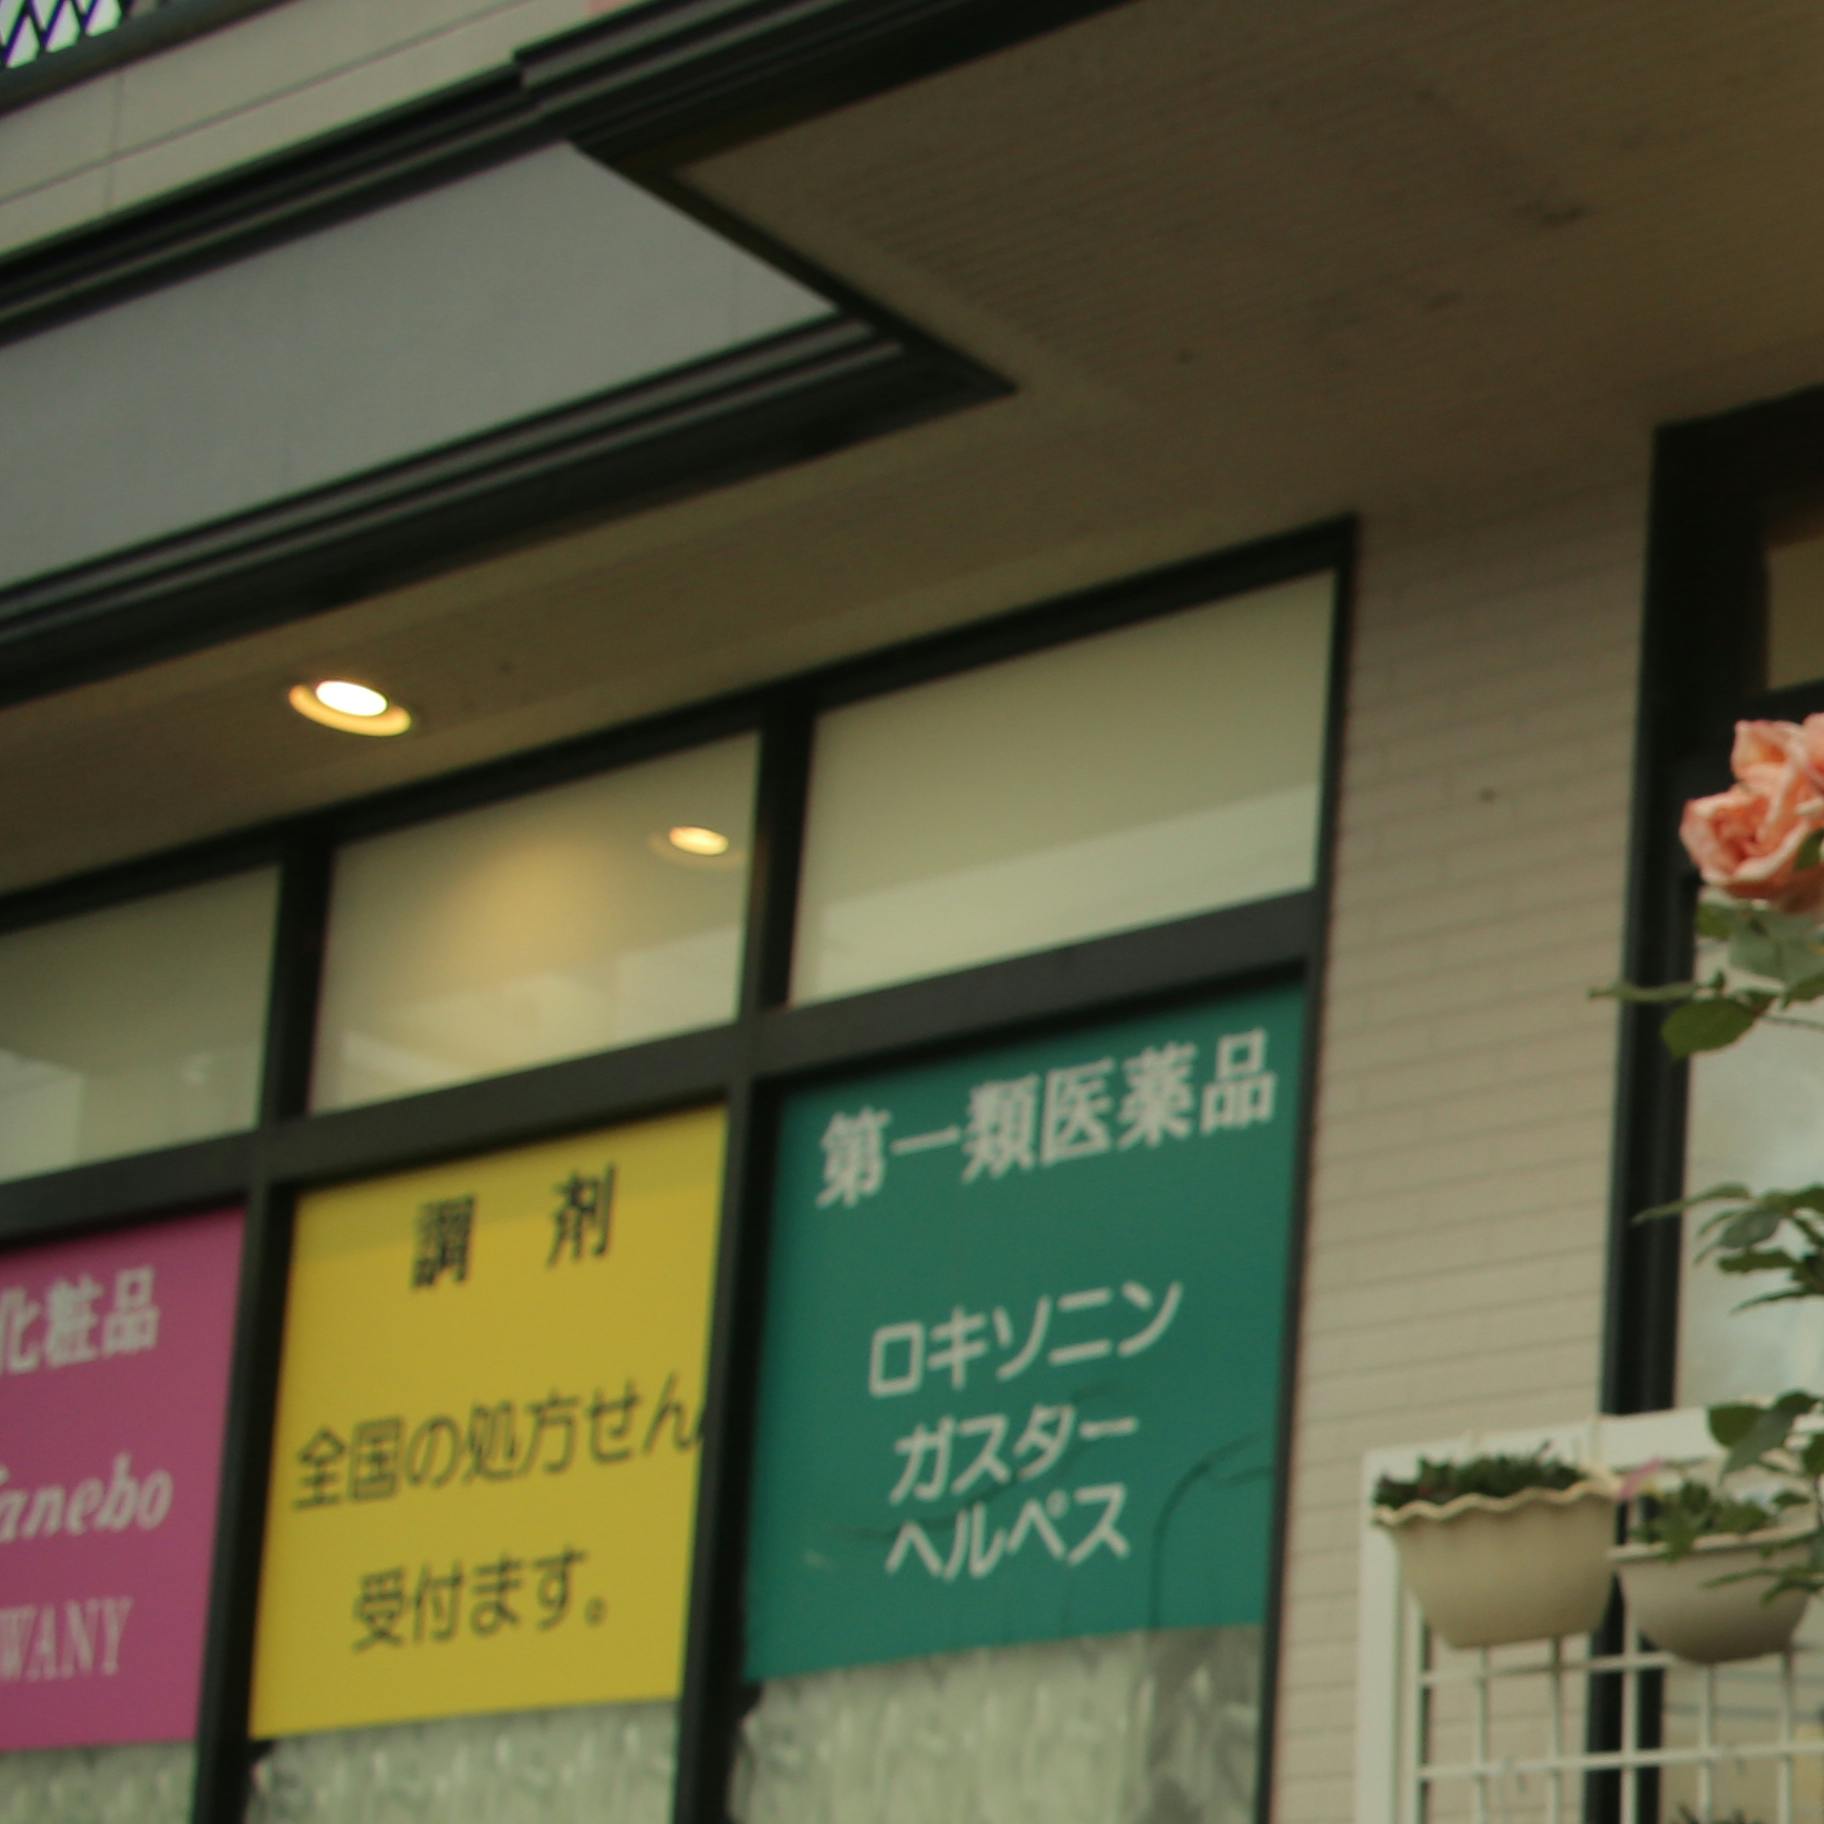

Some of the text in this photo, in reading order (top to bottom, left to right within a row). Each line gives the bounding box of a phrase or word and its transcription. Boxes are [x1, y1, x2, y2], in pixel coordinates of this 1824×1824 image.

[815, 1026, 1277, 1209] 第一類医薬品
[409, 1166, 618, 1292] 調剤
[868, 1280, 1182, 1398] ロキソニン
[0, 1450, 173, 1545] anebo
[291, 1371, 705, 1512] 全国の処方せん
[889, 1403, 1138, 1504] ガスター
[884, 1482, 1131, 1583] ヘルペス
[351, 1545, 607, 1654] 受付ます。
